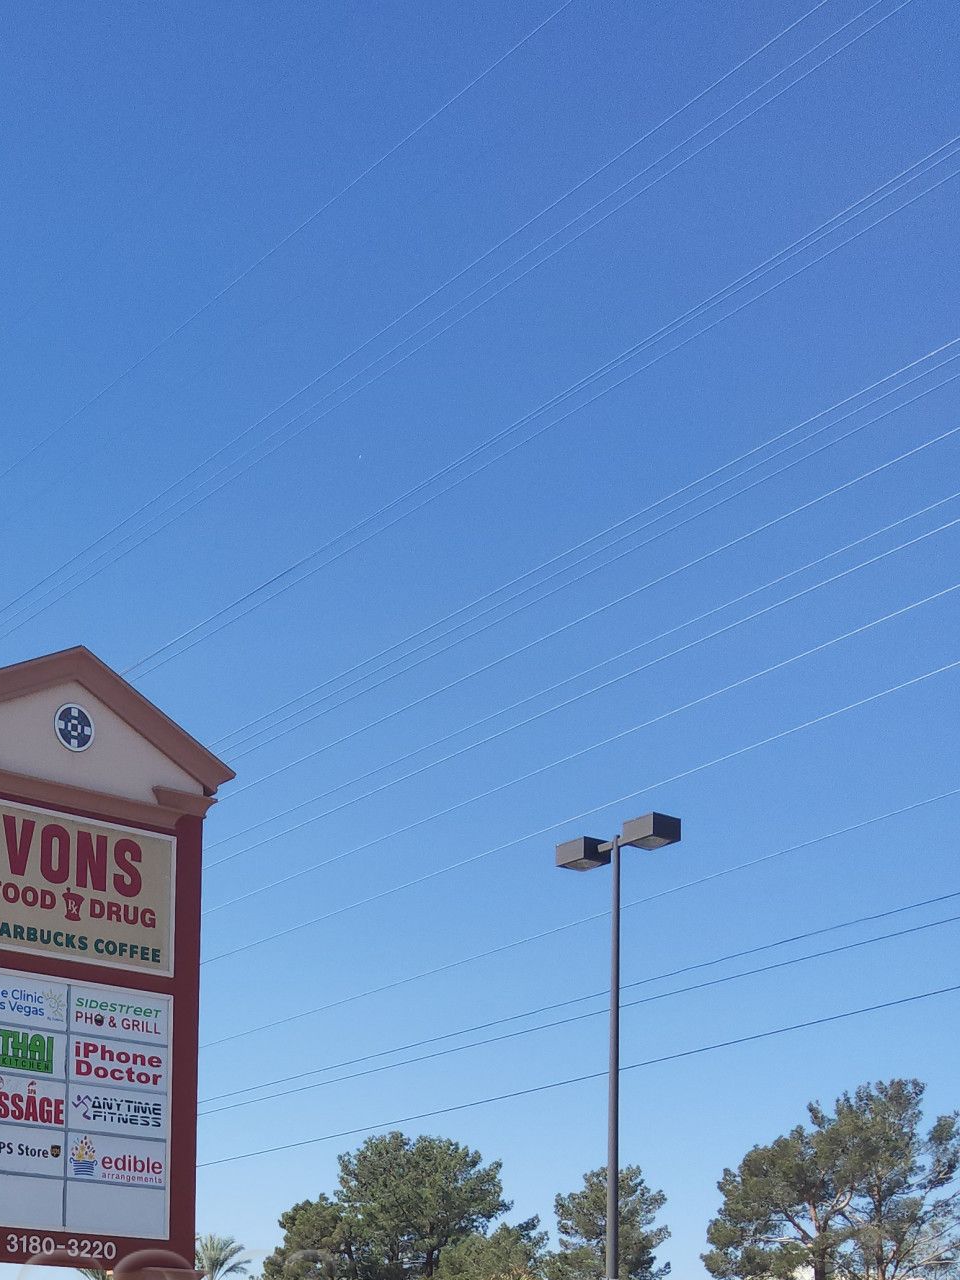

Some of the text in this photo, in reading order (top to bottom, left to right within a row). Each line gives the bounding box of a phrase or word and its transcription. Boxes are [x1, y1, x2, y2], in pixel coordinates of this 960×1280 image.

[2, 814, 142, 898] VONS
[90, 899, 156, 928] DRUG
[94, 938, 161, 963] COFFEE
[11, 989, 43, 1004] Clinic
[9, 1001, 44, 1017] Vegas
[108, 1015, 117, 1028] &
[121, 1018, 161, 1034] GRILL
[0, 1029, 54, 1062] THAI
[75, 1041, 162, 1068] iPhone
[2, 1057, 49, 1071] KITCHEN
[75, 1059, 162, 1086] Doctor
[92, 1096, 162, 1115] ANYTIME
[92, 1111, 162, 1128] FITNESS
[18, 1144, 49, 1158] Store
[101, 1155, 163, 1175] edible
[101, 1172, 163, 1184] arrangements
[6, 1234, 117, 1259] 3180-3220
